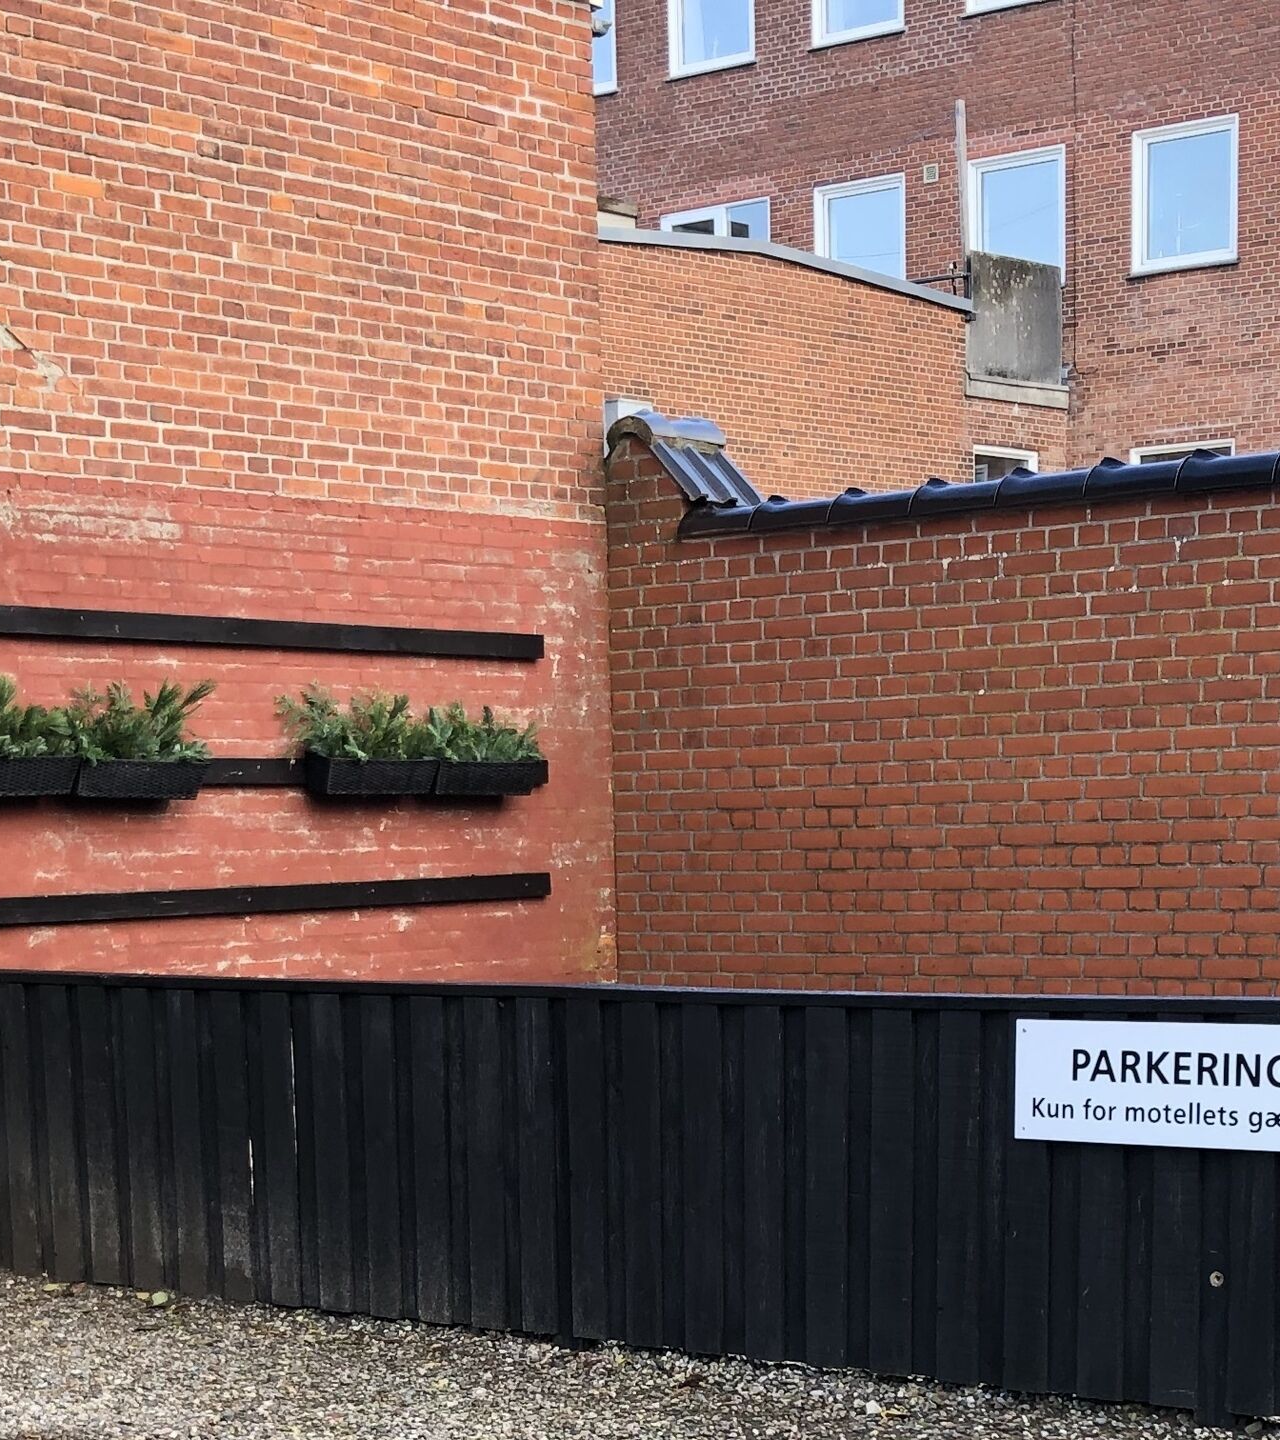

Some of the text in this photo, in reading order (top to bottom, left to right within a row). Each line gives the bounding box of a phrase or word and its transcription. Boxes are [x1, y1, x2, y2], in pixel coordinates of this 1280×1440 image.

[1031, 1097, 1074, 1119] Kun
[1084, 1099, 1117, 1121] for
[1125, 1103, 1239, 1126] motellets
